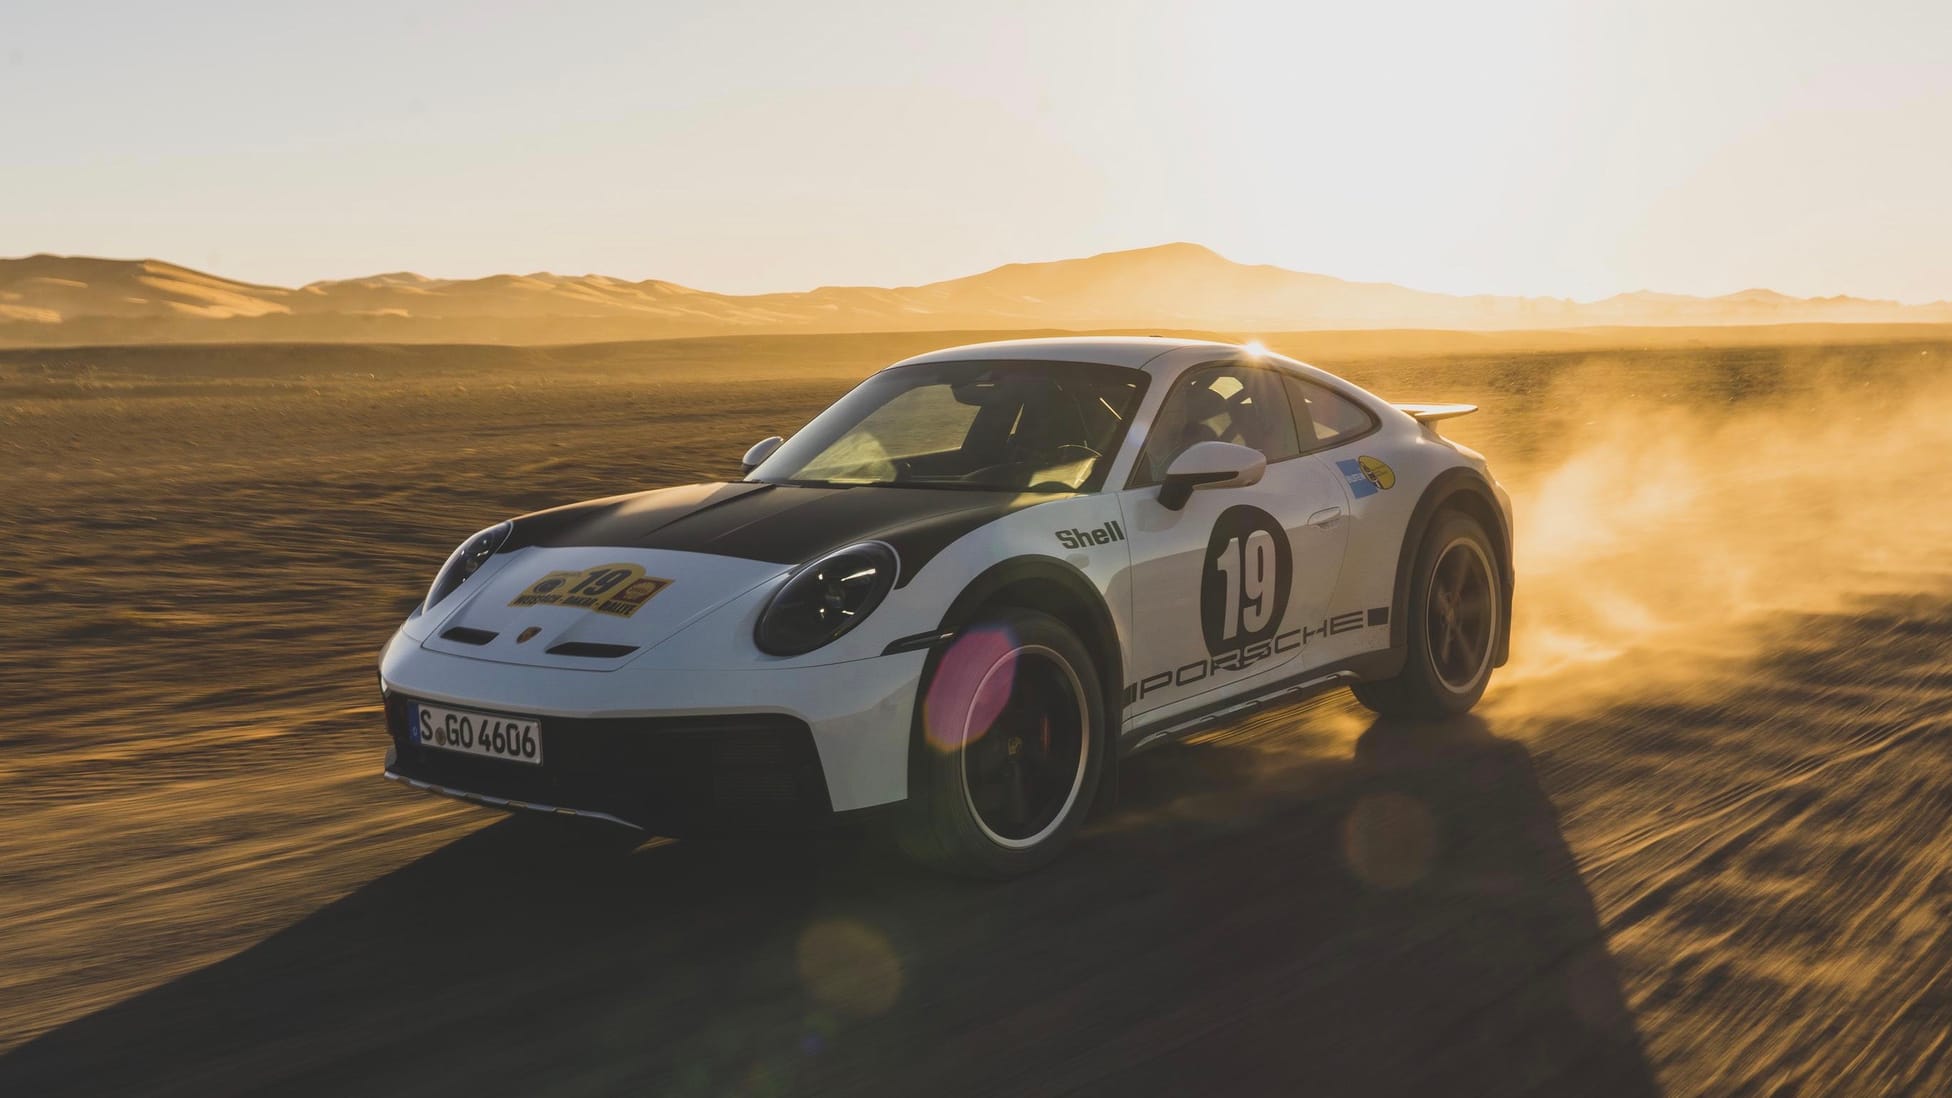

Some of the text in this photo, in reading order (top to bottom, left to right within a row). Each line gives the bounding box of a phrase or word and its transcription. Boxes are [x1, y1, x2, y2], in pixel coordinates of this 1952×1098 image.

[1055, 520, 1125, 549] Shell
[568, 568, 633, 596] 19
[1216, 529, 1276, 641] 19
[1139, 610, 1364, 700] PORSCHE
[420, 709, 536, 758] S GO 4606
